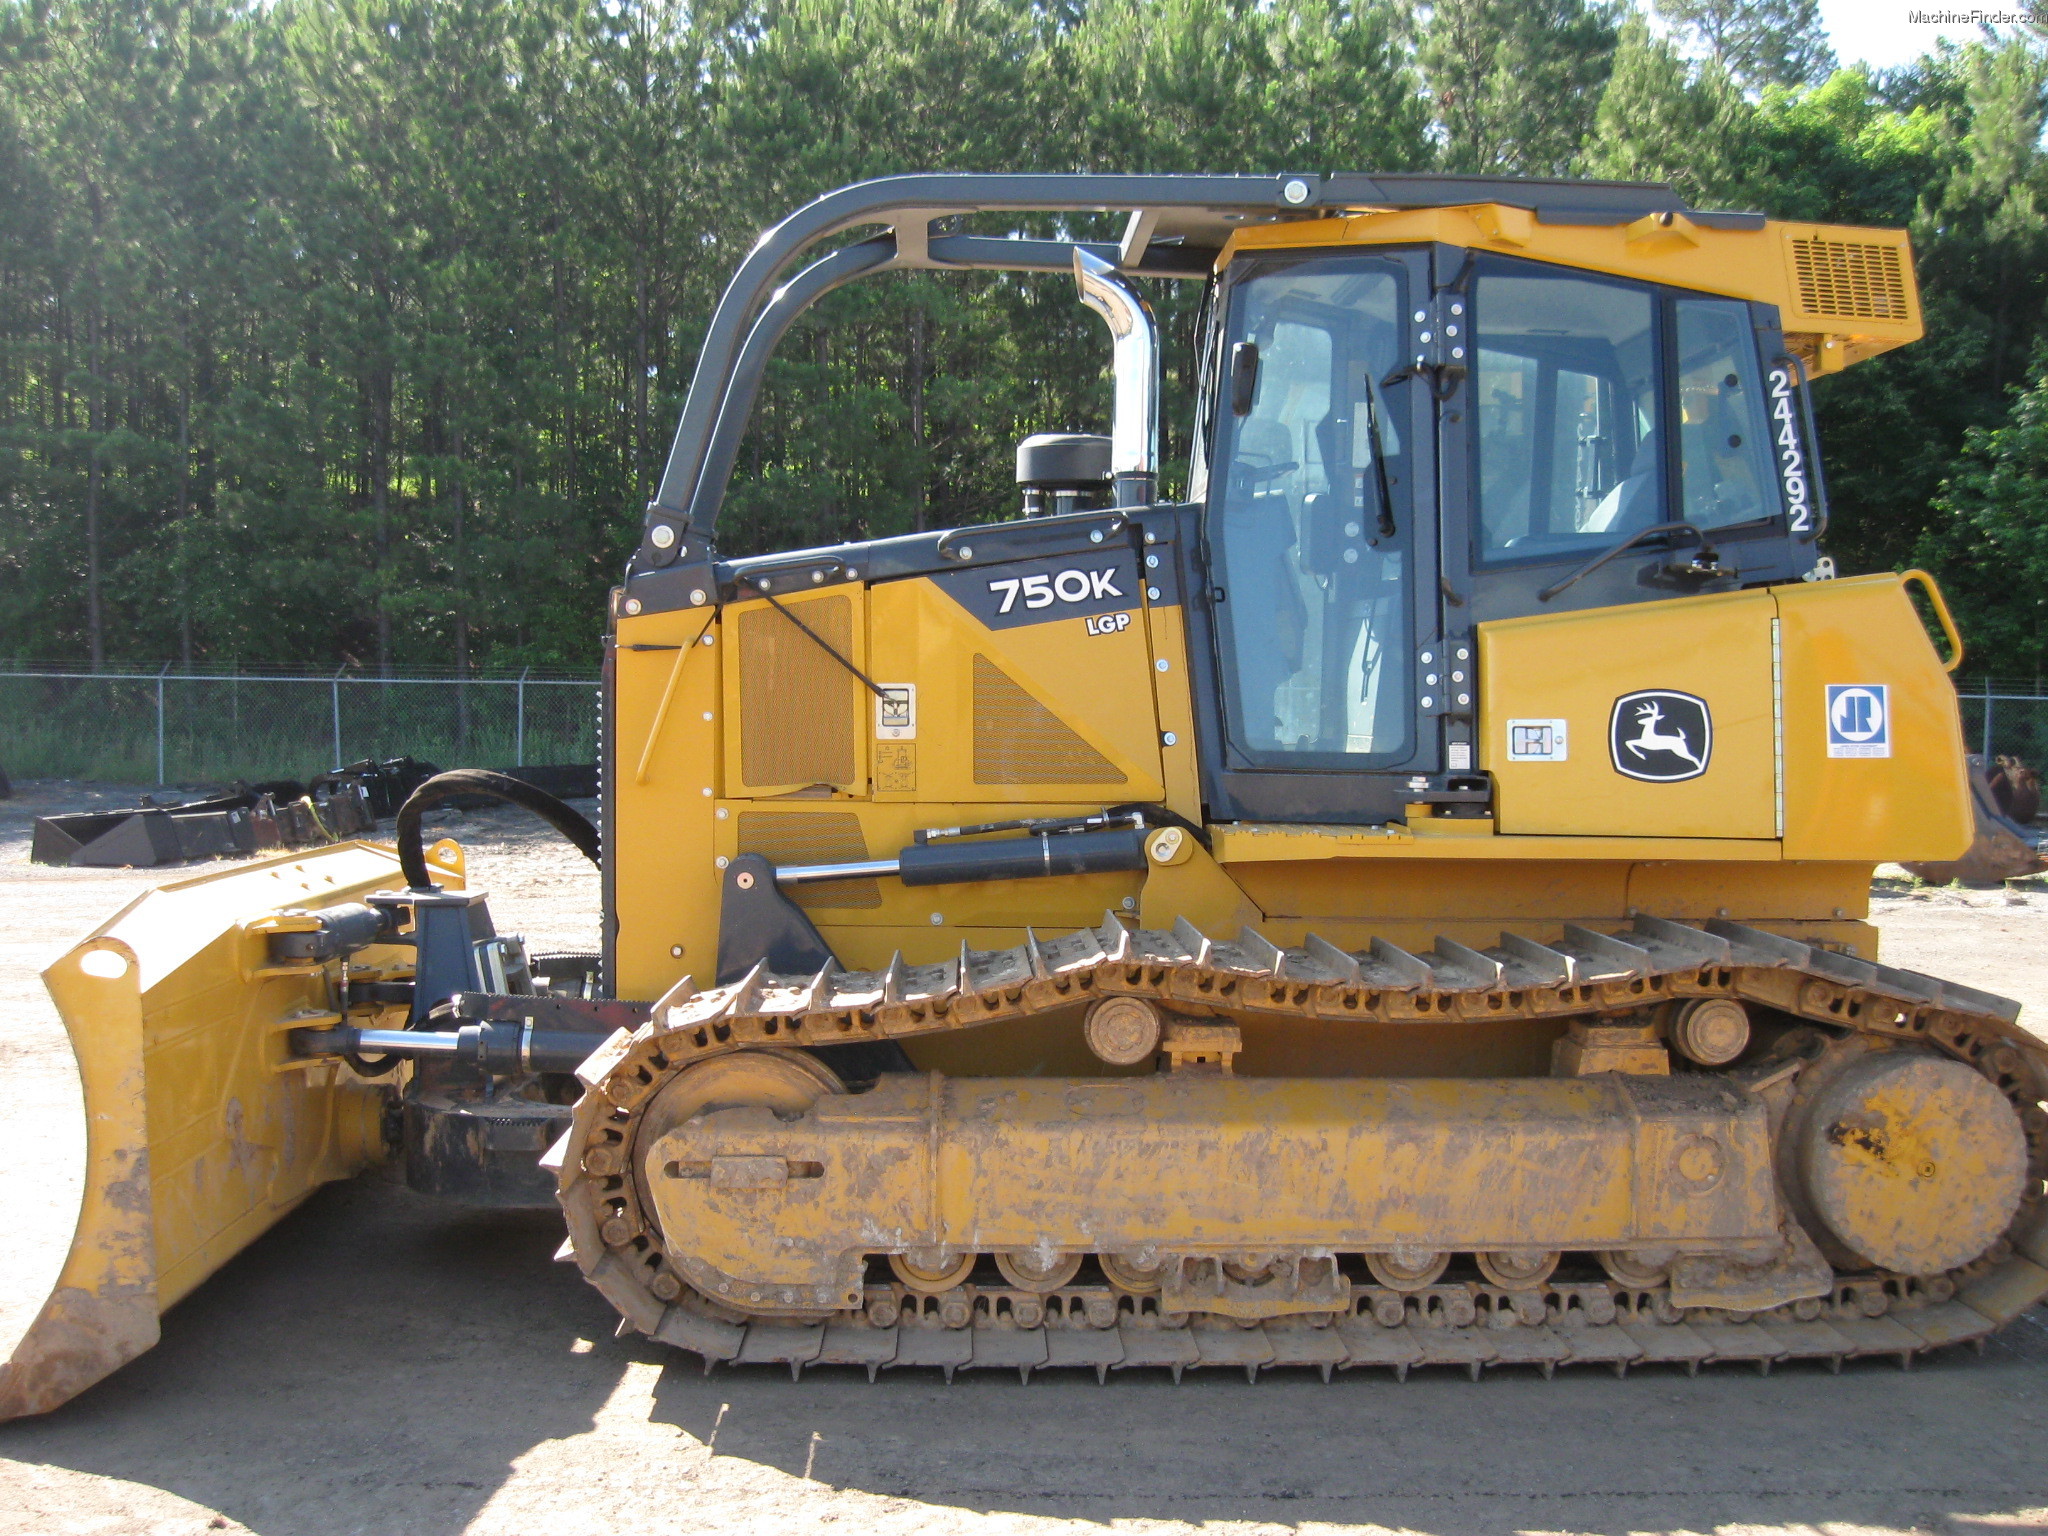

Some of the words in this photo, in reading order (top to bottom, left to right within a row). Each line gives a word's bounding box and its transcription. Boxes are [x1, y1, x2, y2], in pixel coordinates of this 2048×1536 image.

[1768, 370, 1809, 532] 244292
[989, 567, 1123, 614] 750K
[1085, 613, 1131, 637] LGP
